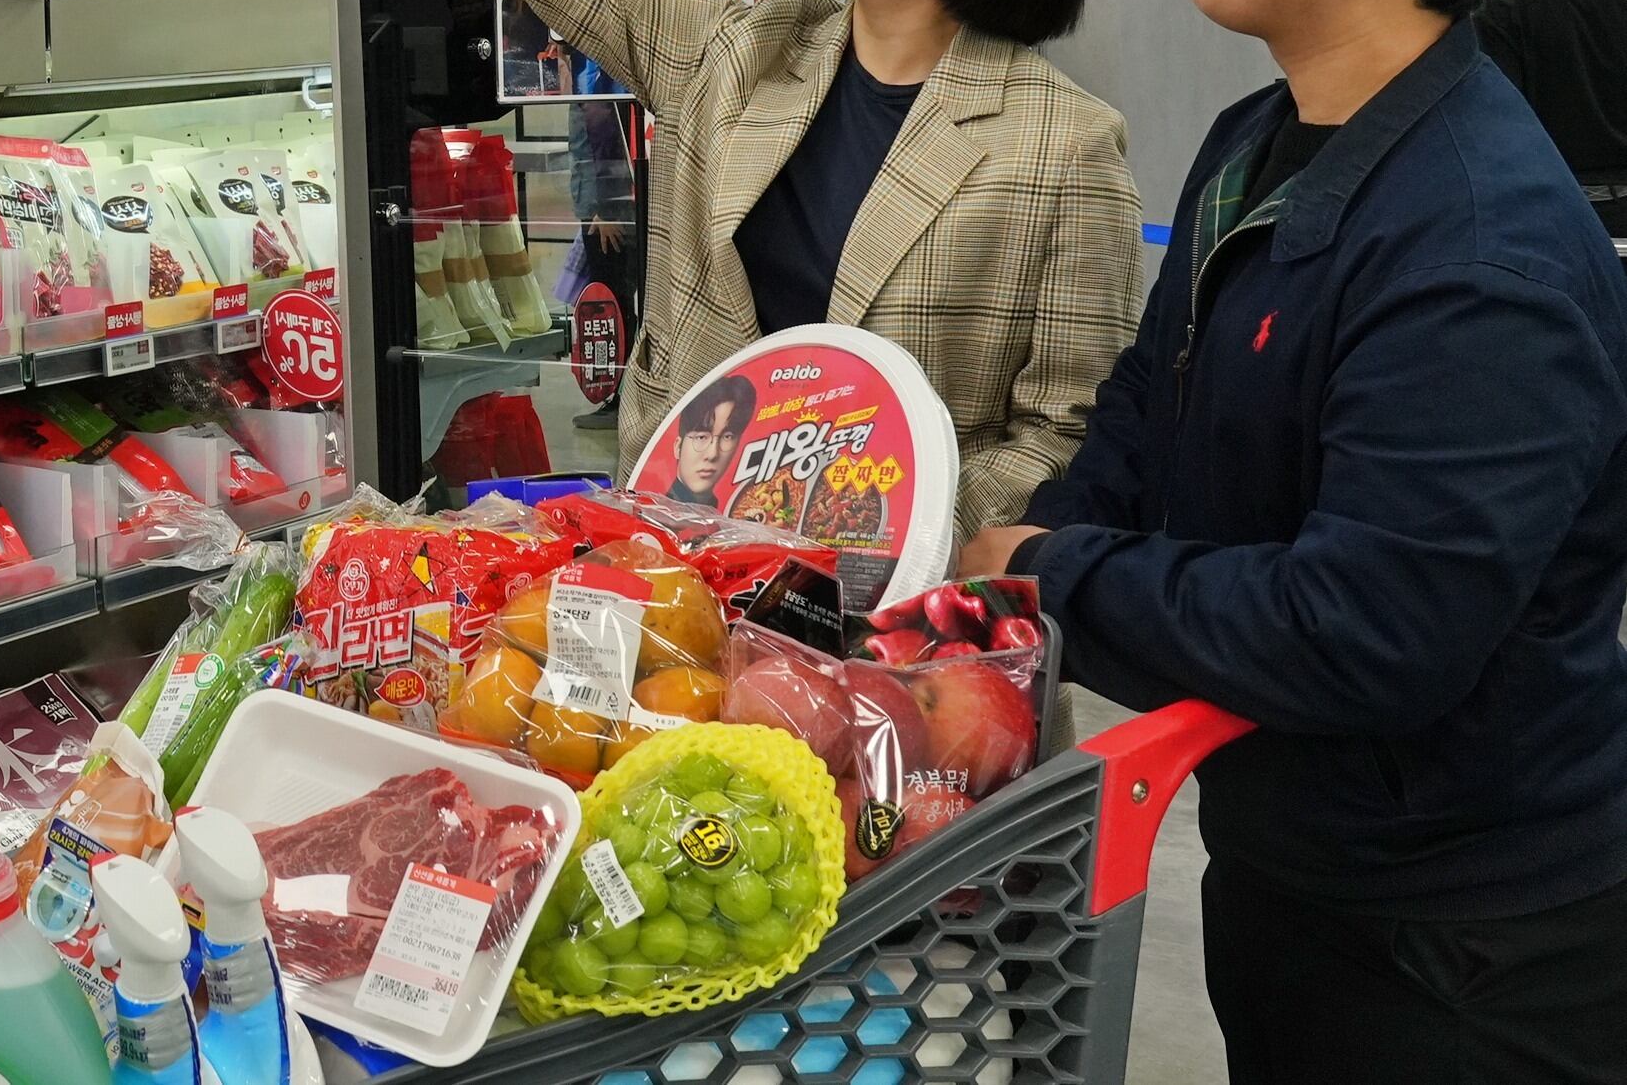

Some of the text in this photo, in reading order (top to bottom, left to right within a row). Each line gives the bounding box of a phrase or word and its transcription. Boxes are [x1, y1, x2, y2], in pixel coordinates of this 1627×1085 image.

[770, 363, 822, 384] paldo
[732, 420, 875, 485] 대왕 뚜껑
[343, 580, 364, 593] 오뚜기
[385, 676, 419, 699] 매운맛
[694, 821, 726, 851] 16
[431, 977, 459, 998] 36419
